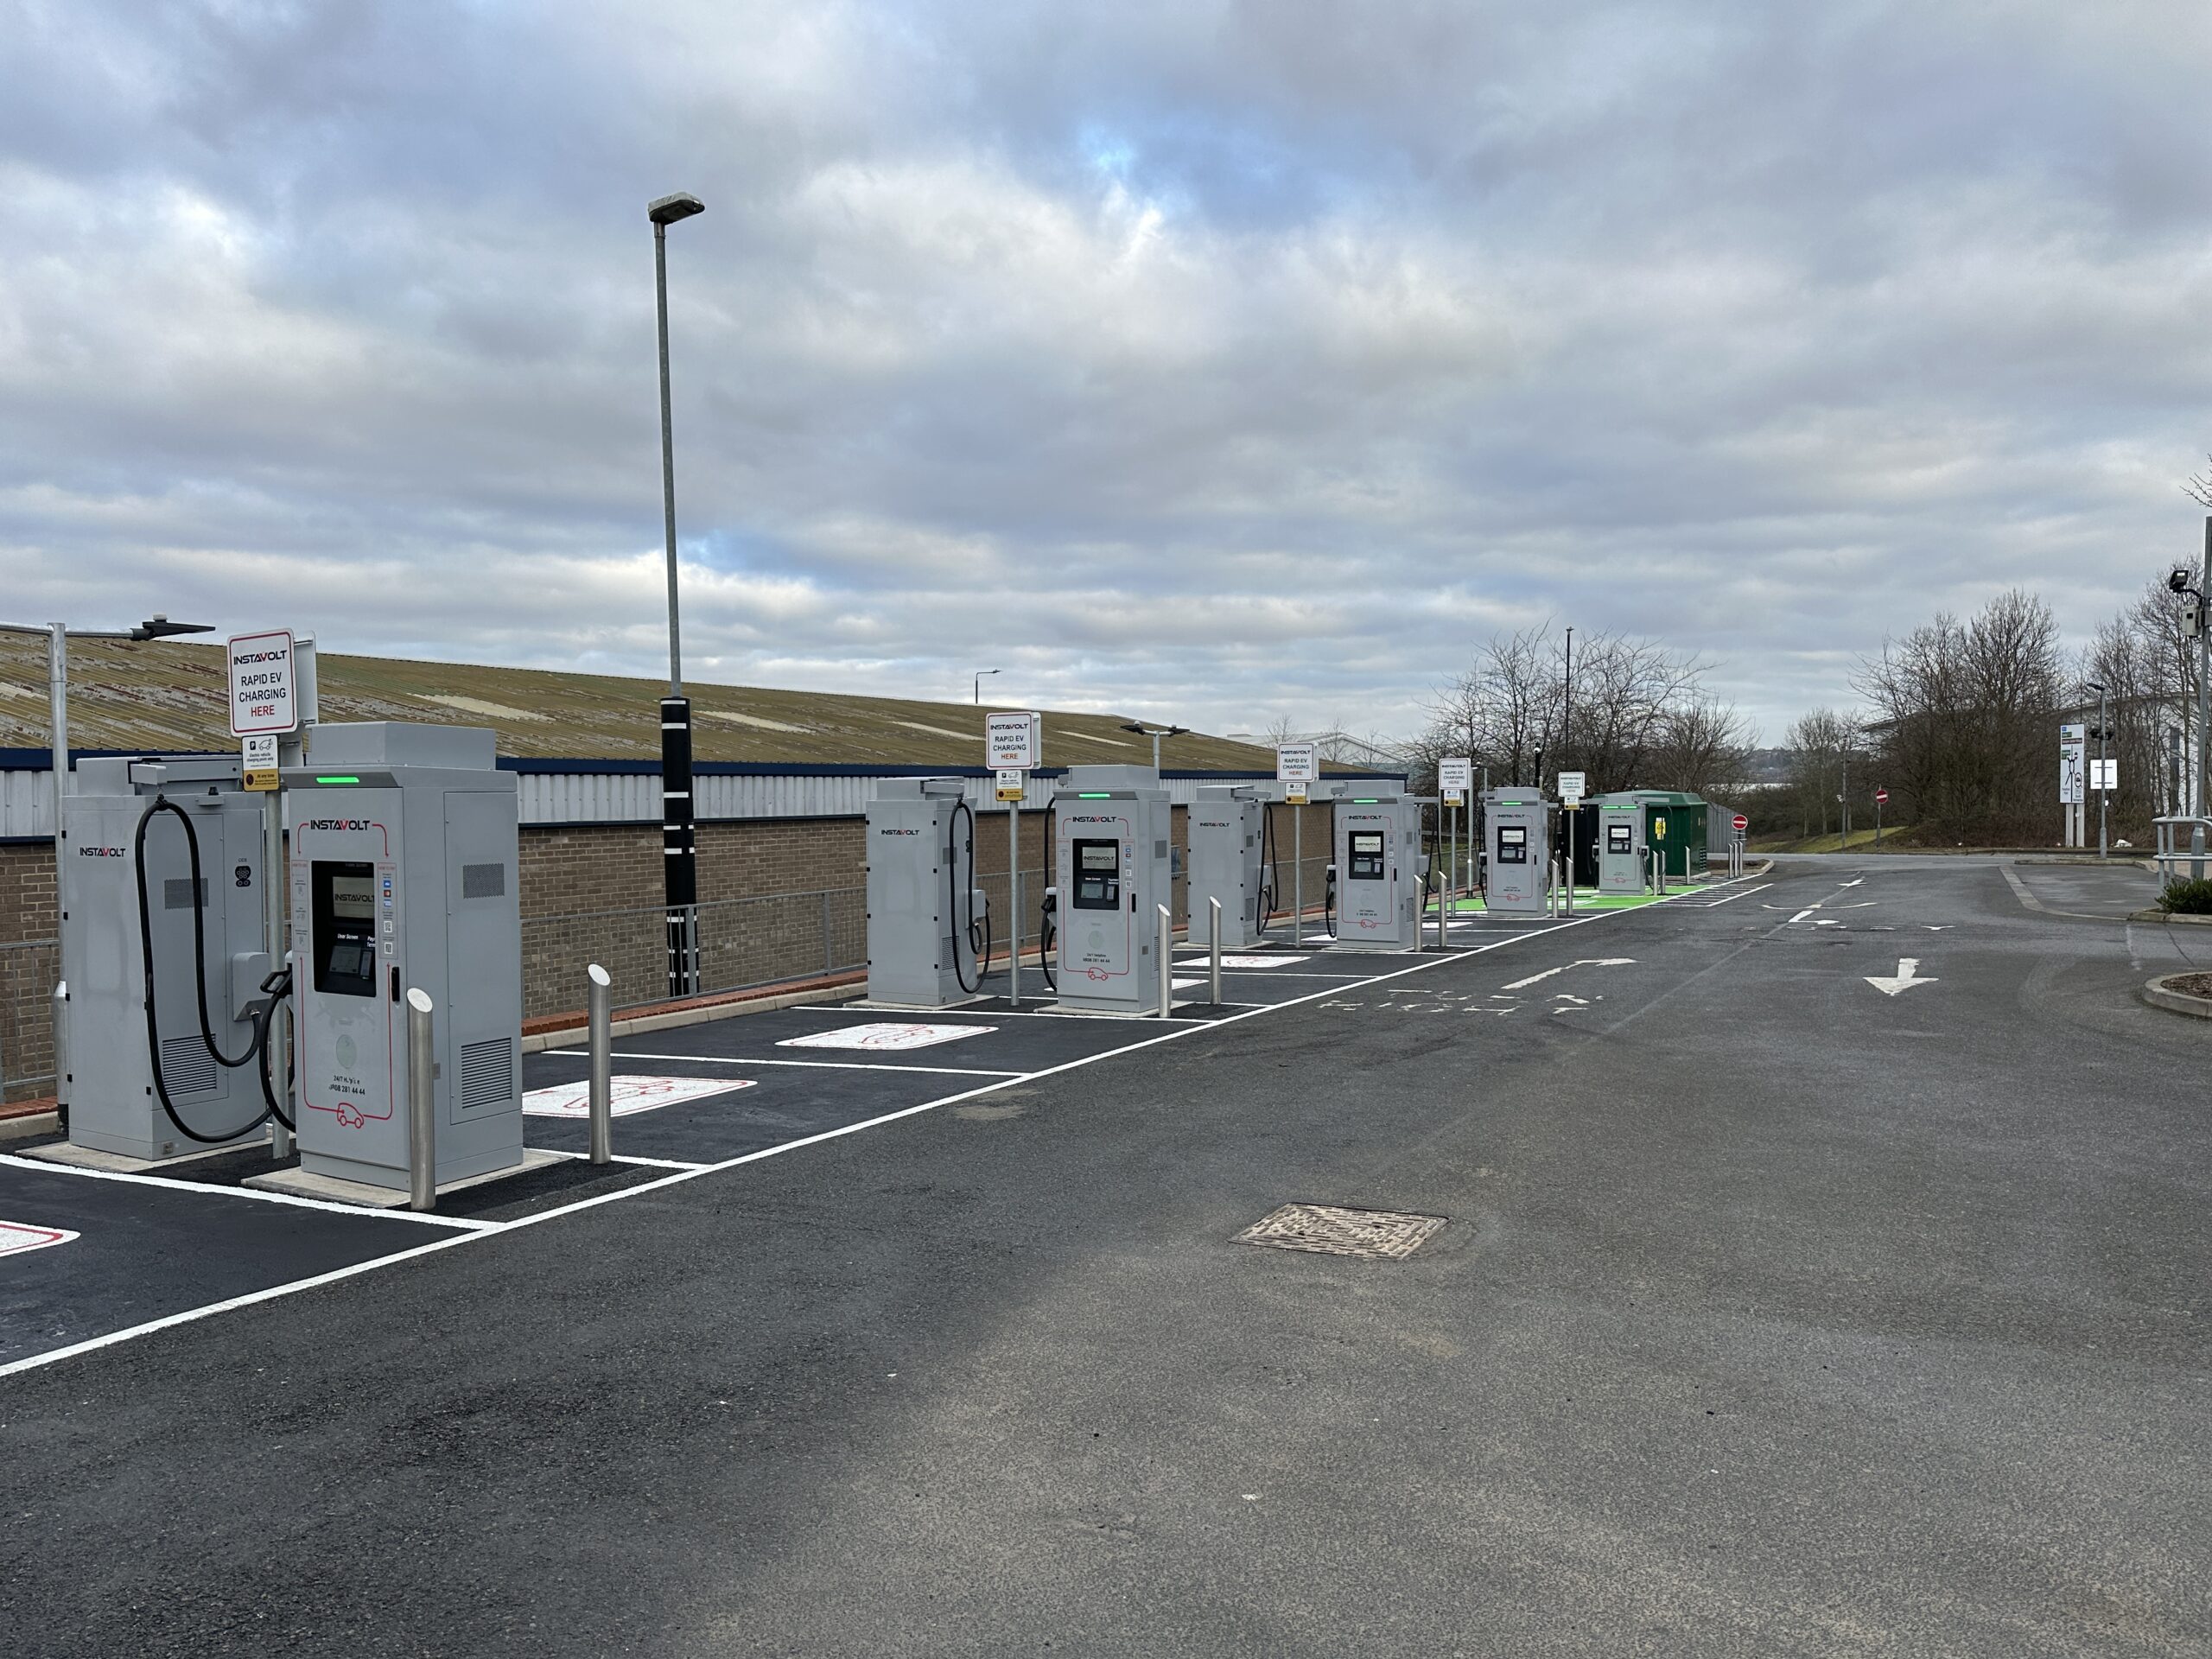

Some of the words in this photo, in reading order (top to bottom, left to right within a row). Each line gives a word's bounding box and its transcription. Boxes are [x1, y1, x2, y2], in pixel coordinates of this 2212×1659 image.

[234, 650, 287, 665] INSTAVOLT
[241, 674, 268, 686] RAPID
[270, 672, 282, 683] EV
[239, 688, 286, 702] CHARGING
[251, 705, 275, 717] HERE
[310, 819, 370, 830] INSTAVOLT
[79, 847, 126, 857] INSTAVOLT
